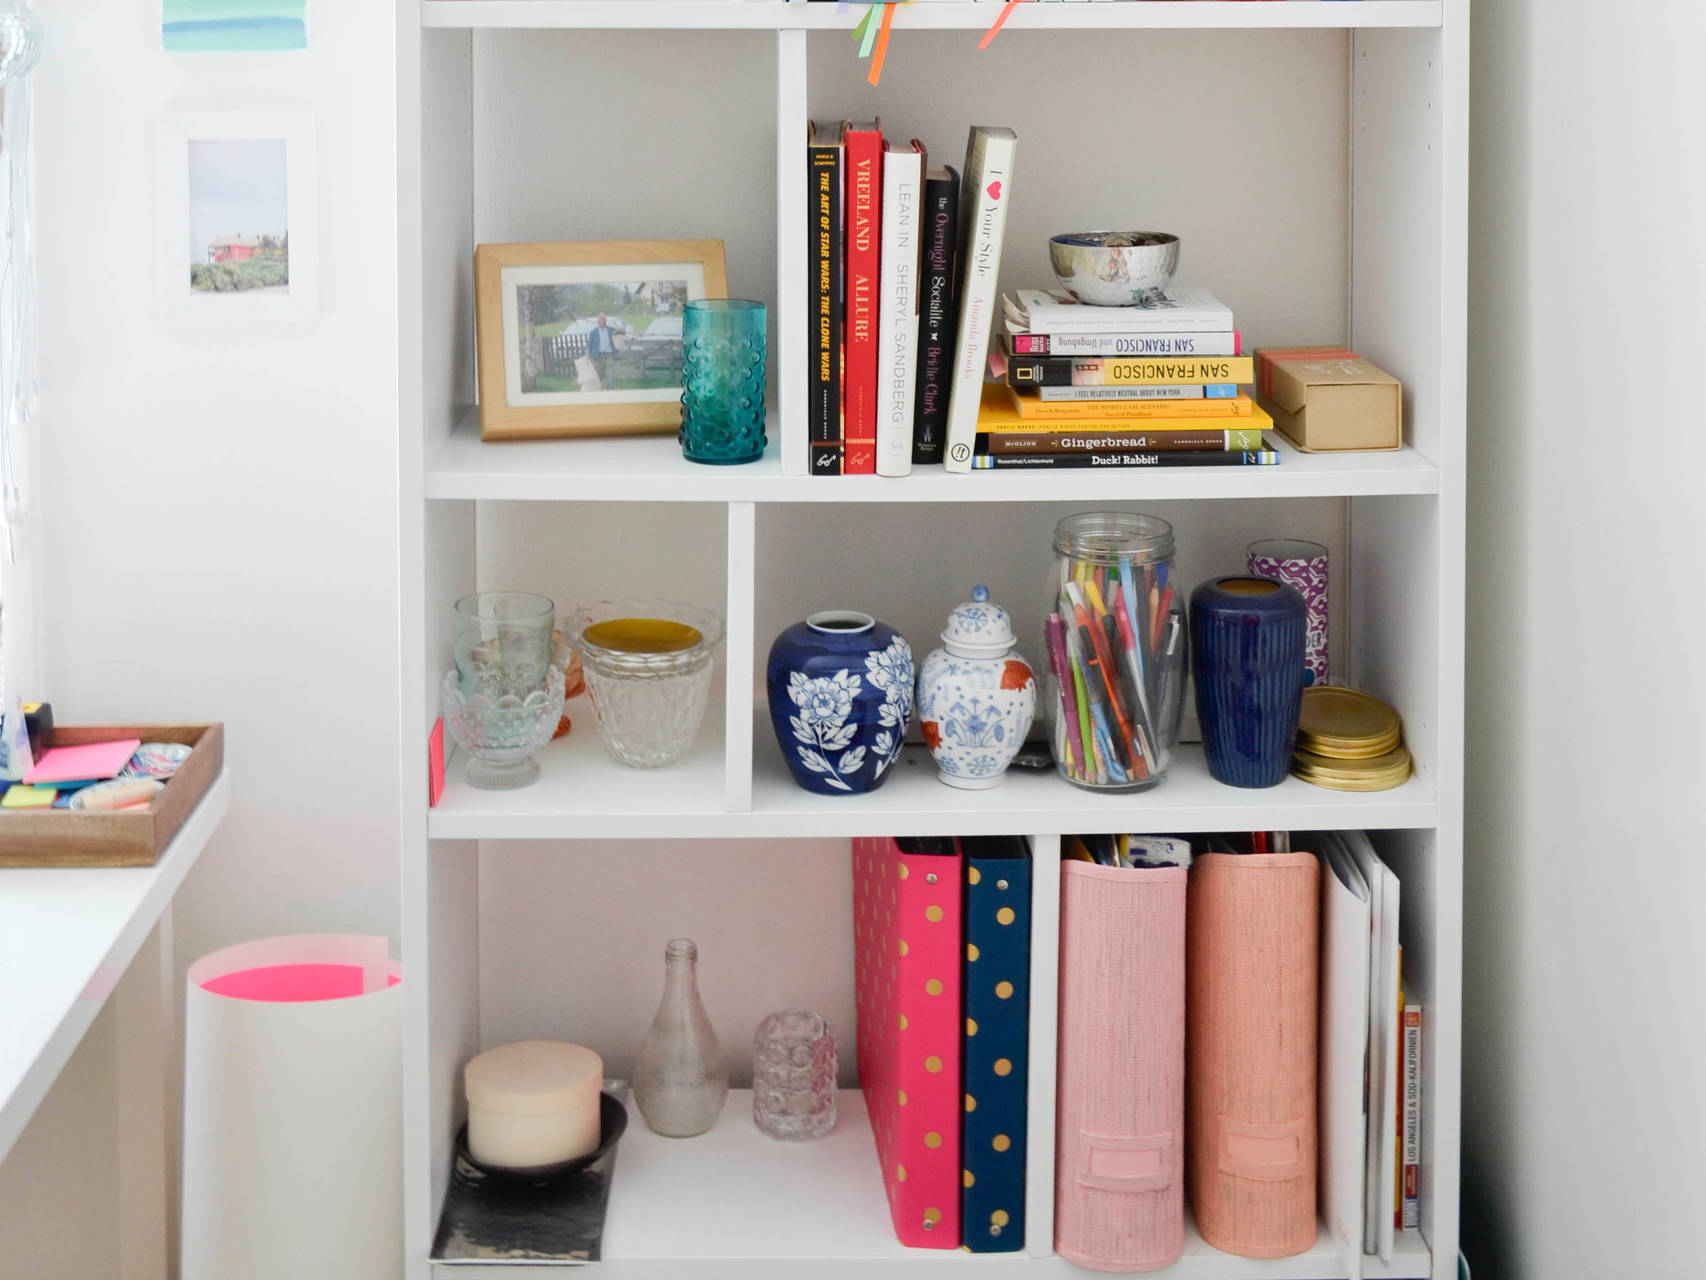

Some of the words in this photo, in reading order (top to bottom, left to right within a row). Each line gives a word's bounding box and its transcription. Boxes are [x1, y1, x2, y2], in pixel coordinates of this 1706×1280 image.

[820, 172, 830, 192] THE
[820, 193, 830, 215] ART
[856, 158, 872, 251] VREELAND
[898, 183, 911, 226] LEAN
[938, 197, 948, 210] the
[820, 216, 830, 230] OF
[982, 206, 998, 239] Your
[820, 232, 830, 257] STAR
[897, 232, 910, 248] IN
[929, 212, 950, 271] Overnight
[975, 242, 993, 277] Style
[820, 259, 830, 293] WARS:
[820, 295, 830, 314] THE
[855, 274, 870, 342] ALLURE
[895, 264, 909, 326] SHERYL
[929, 276, 946, 328] Socialite
[820, 316, 830, 350] CLONE
[968, 297, 984, 340] Amanda
[1058, 336, 1097, 351] Umgebung
[1098, 339, 1113, 349] und
[1116, 339, 1171, 352] FRANCISCO
[1174, 339, 1195, 352] SAN
[820, 351, 830, 382] WARS
[892, 332, 906, 423] SANDBERG
[926, 346, 942, 380] Bridie
[964, 345, 977, 381] Brooks
[1113, 364, 1195, 380] FRANCISCO
[1200, 364, 1229, 379] SAN
[923, 383, 940, 416] Clark
[1060, 436, 1147, 450] Gingerbread
[1091, 455, 1121, 465] Duck!
[1123, 455, 1159, 465] Rabbit!
[1407, 1110, 1417, 1145] ANGELES
[1407, 1146, 1417, 1162] LOS
